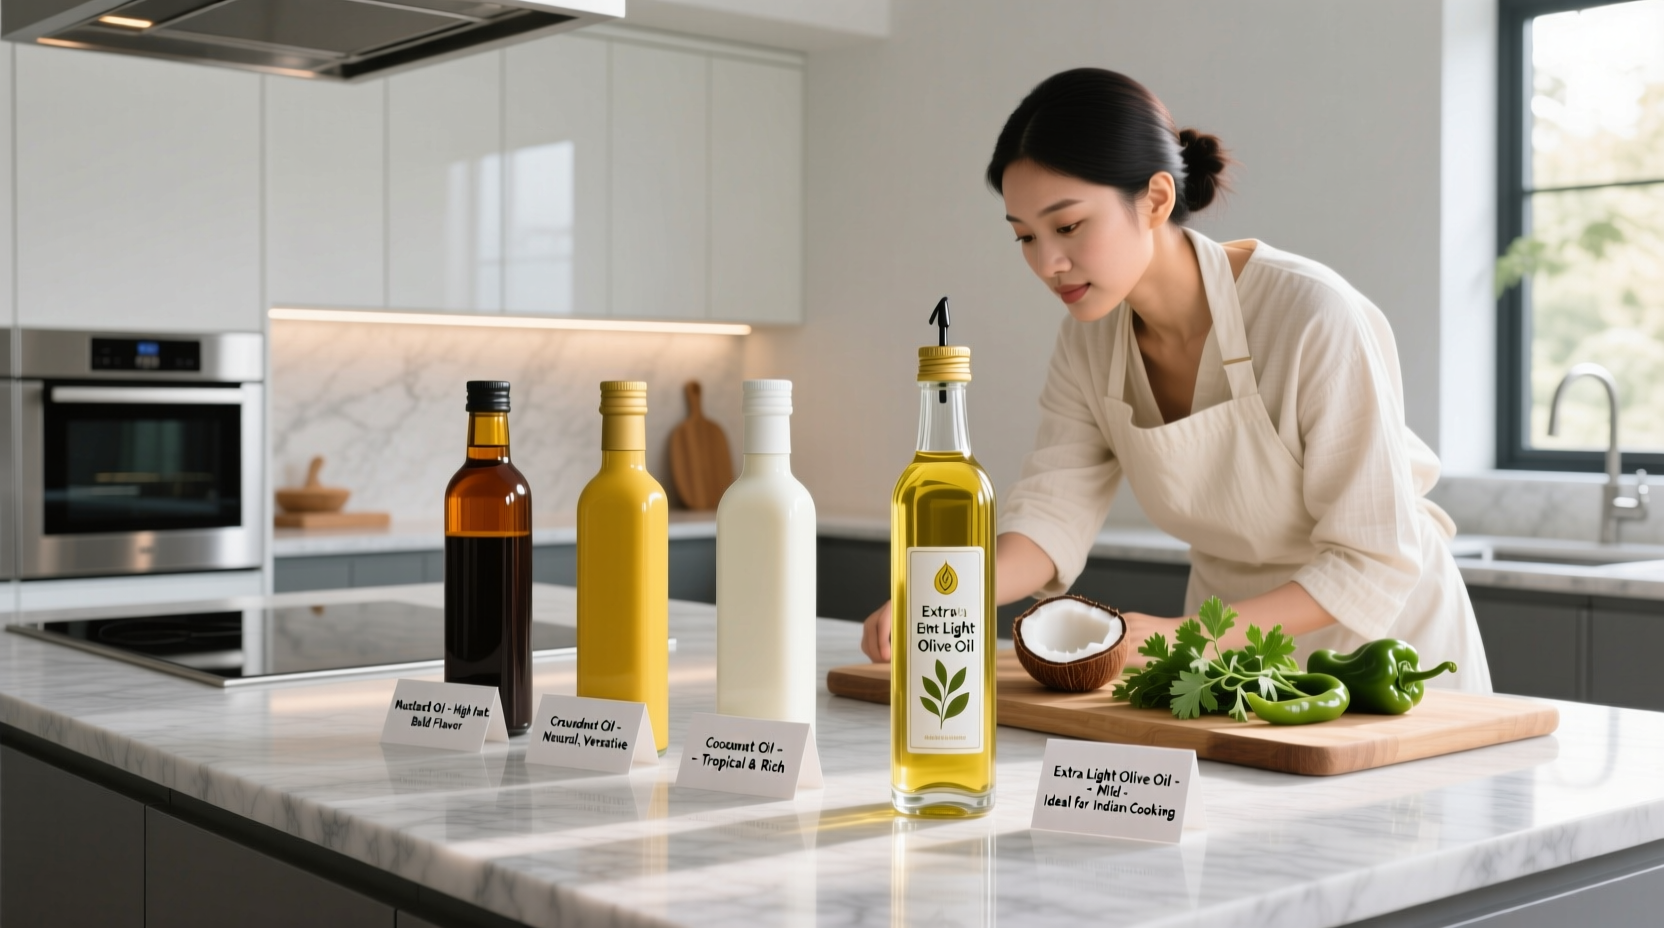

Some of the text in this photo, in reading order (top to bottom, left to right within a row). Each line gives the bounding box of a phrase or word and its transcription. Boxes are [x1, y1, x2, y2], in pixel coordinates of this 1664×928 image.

[943, 621, 975, 638] Light
[918, 639, 974, 652] Olive Oil
[433, 718, 463, 730] Flavor
[758, 742, 774, 754] Oil
[702, 754, 746, 771] Tropical
[761, 759, 784, 773] Rich
[1054, 765, 1083, 778] Extra
[1087, 768, 1117, 783] Light
[1120, 771, 1150, 785] Olive
[1154, 773, 1172, 786] Oil
[1044, 794, 1071, 808] Ideal
[1093, 800, 1127, 813] Indian
[1130, 803, 1175, 821] Cooking
